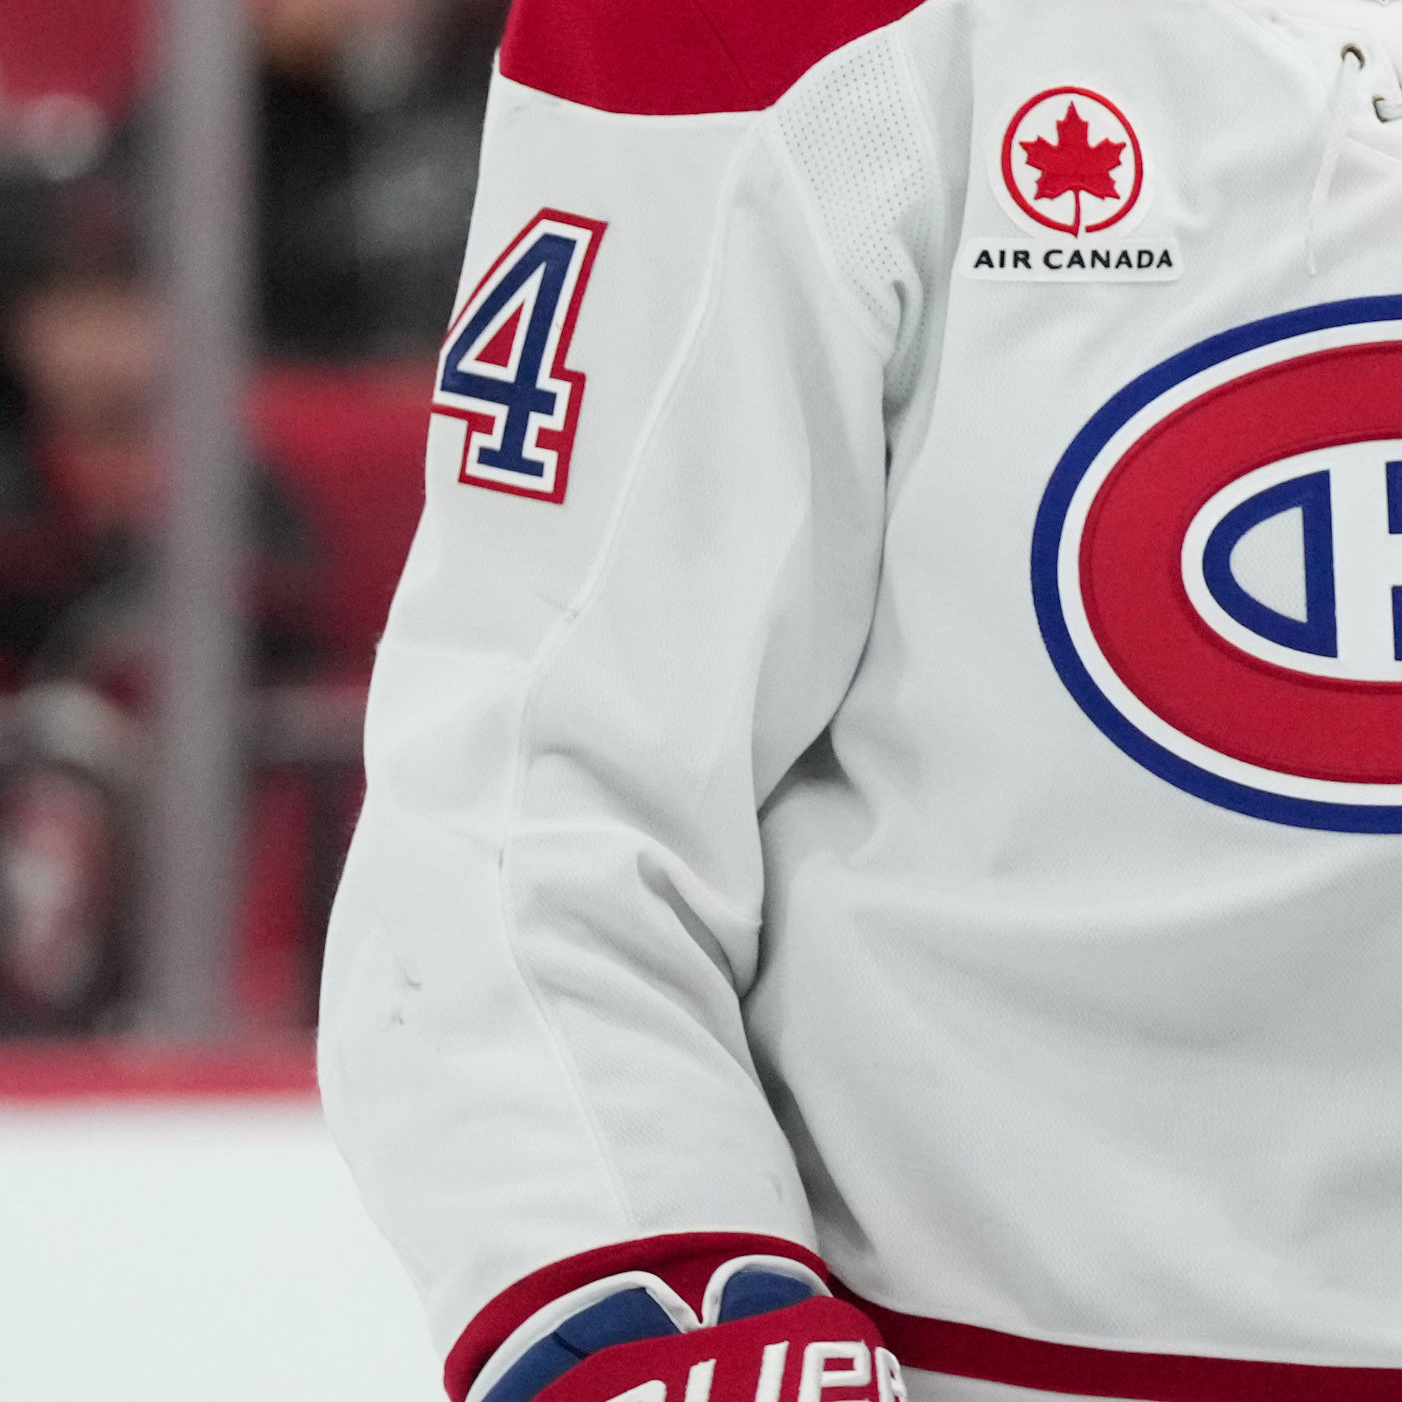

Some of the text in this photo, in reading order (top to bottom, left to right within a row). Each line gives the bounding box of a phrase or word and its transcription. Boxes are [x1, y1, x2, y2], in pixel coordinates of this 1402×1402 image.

[973, 249, 1174, 270] AIR CANADA
[430, 206, 609, 505] 4
